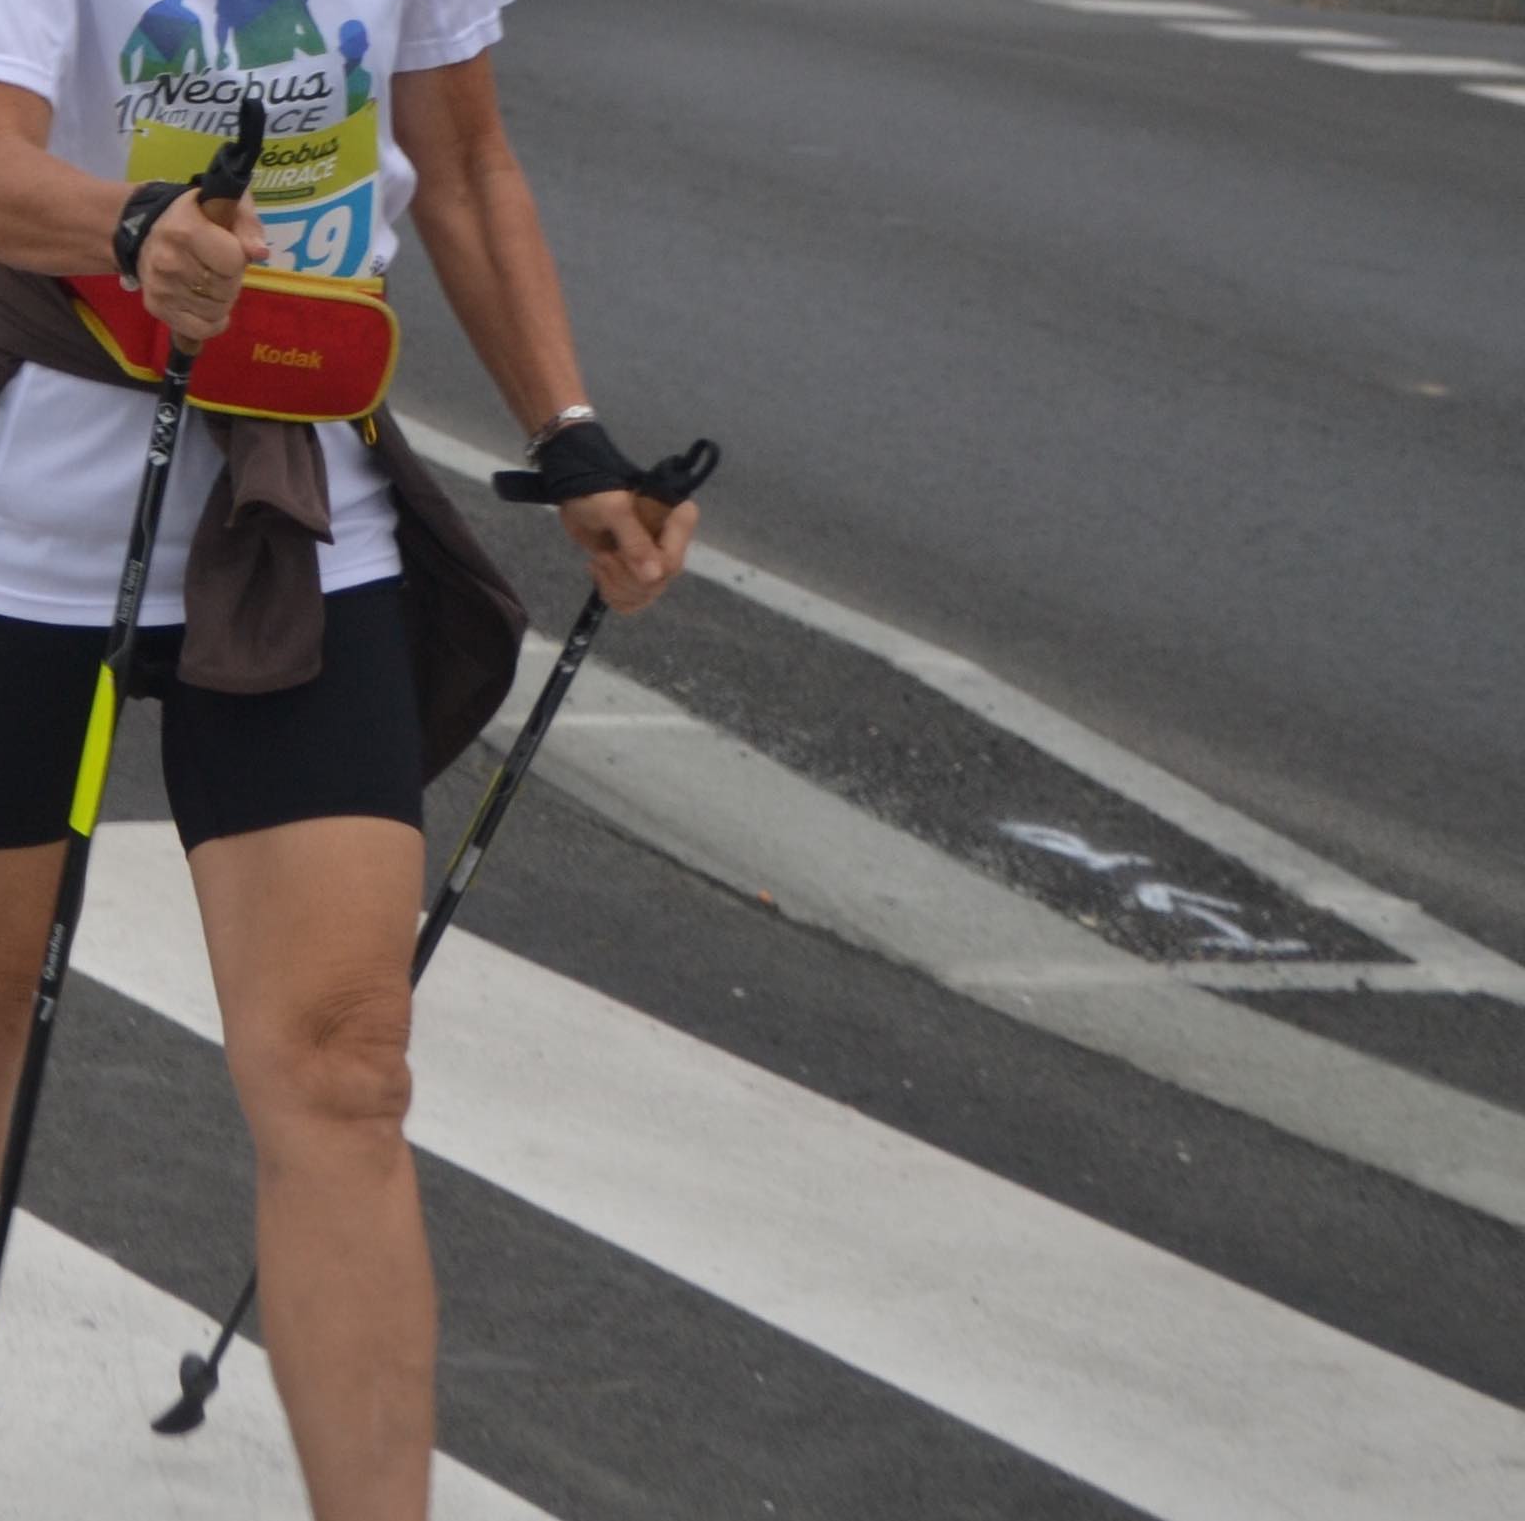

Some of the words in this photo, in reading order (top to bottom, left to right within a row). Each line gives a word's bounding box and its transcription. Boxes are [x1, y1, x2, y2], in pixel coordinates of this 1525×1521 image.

[152, 67, 333, 106] Néobus
[217, 104, 327, 137] RCE
[259, 136, 340, 168] éobus
[252, 343, 324, 370] Kodak
